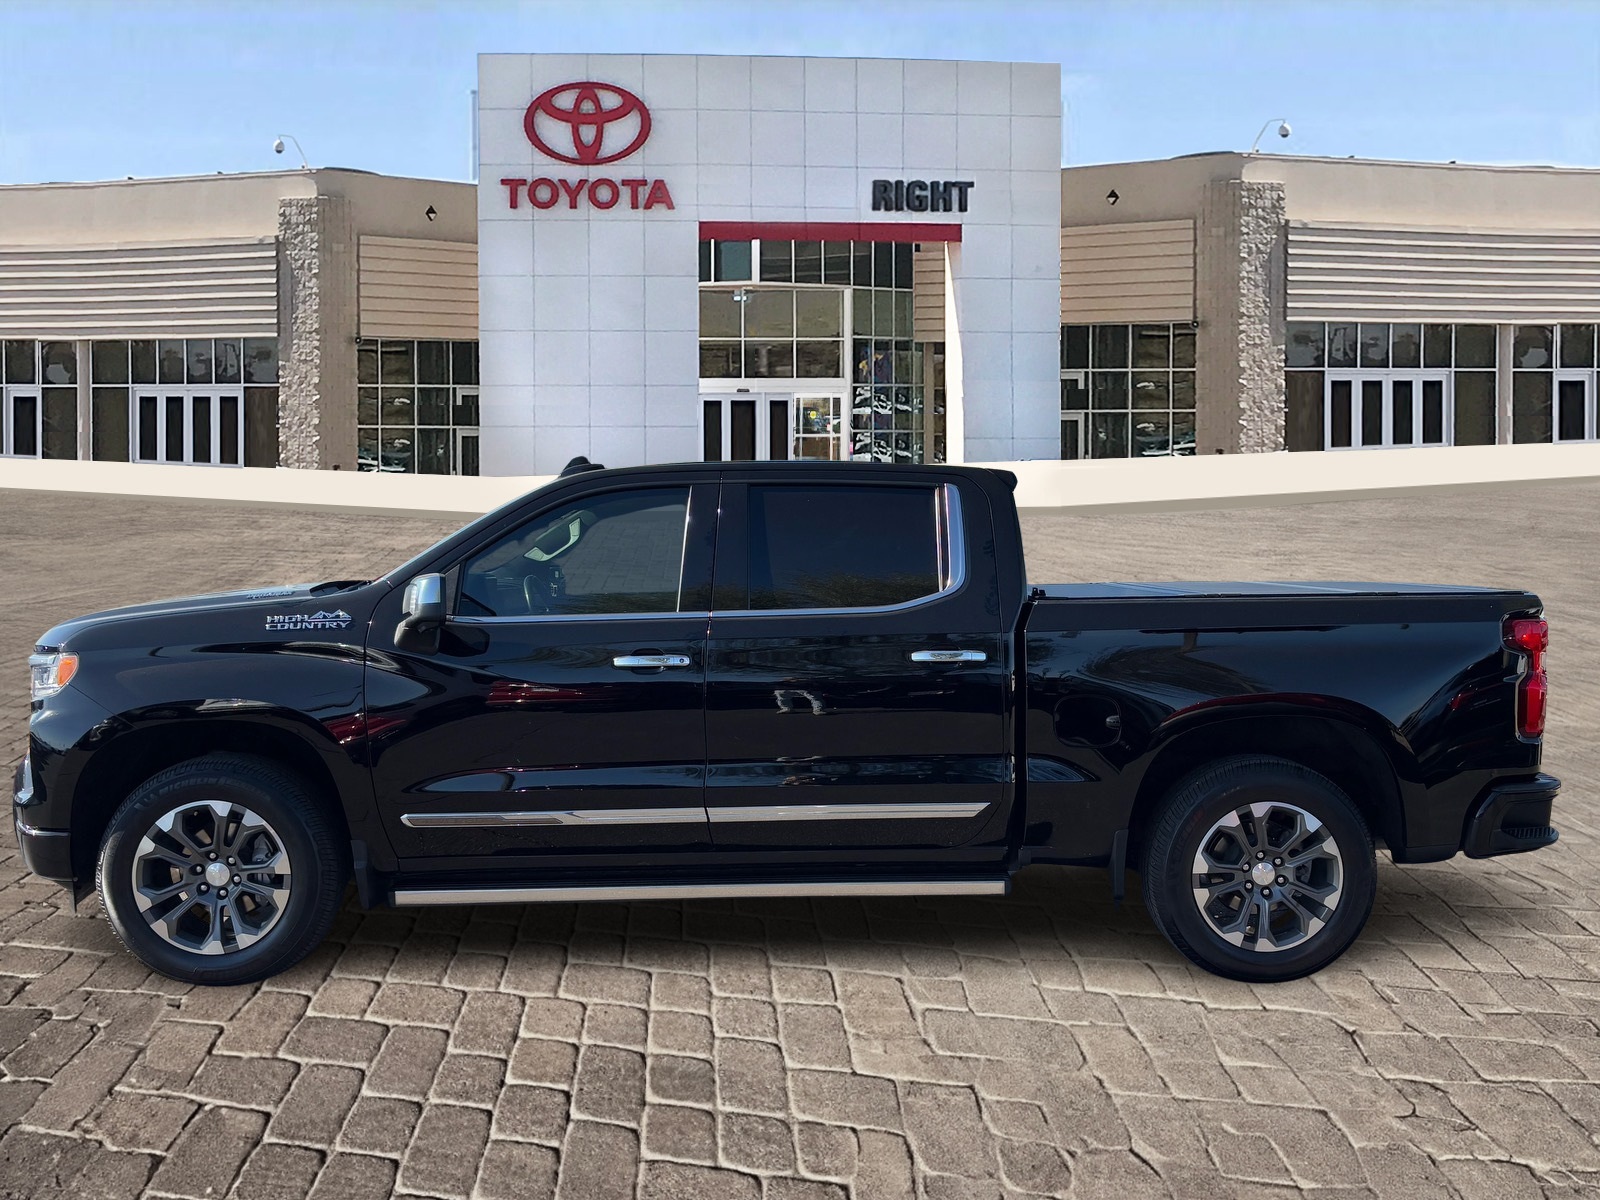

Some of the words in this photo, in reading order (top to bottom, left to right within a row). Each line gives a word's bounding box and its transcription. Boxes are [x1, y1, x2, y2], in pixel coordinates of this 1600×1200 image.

[500, 178, 675, 210] TOYOTA
[872, 179, 975, 212] RIGHT
[265, 621, 351, 631] COUNTRY
[266, 614, 309, 623] HIGH
